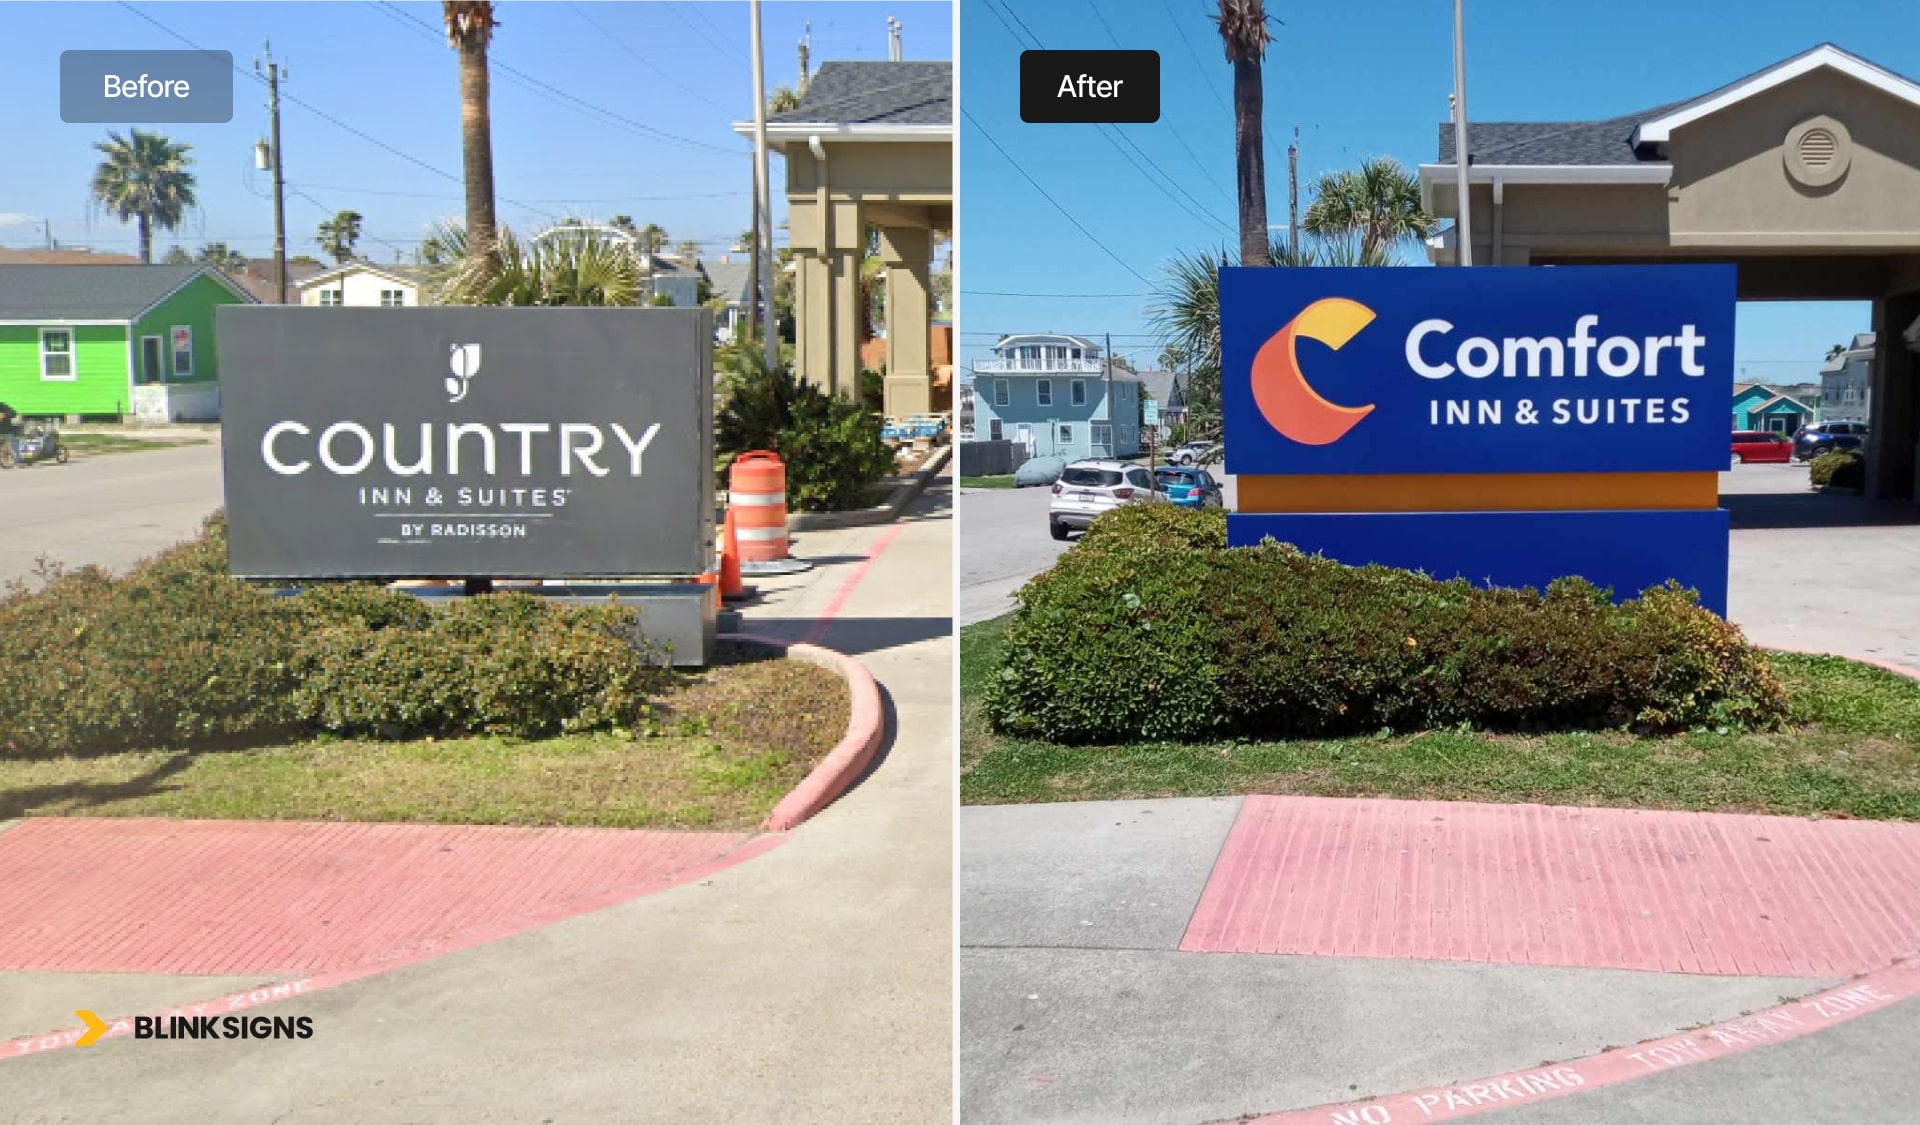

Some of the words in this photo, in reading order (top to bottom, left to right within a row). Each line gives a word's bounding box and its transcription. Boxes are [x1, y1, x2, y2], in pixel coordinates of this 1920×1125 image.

[1405, 314, 1706, 379] Comfort
[1430, 399, 1502, 425] INN
[1515, 398, 1539, 425] &
[1552, 397, 1690, 425] SUITES
[359, 487, 411, 506] INN
[425, 487, 443, 507] &
[457, 487, 567, 507] SUITES
[401, 523, 424, 537] BY
[430, 523, 526, 538] RADISSON
[1331, 1104, 1392, 1125] NO
[1414, 1066, 1585, 1116] PARKING
[1626, 1038, 1704, 1070] TOW
